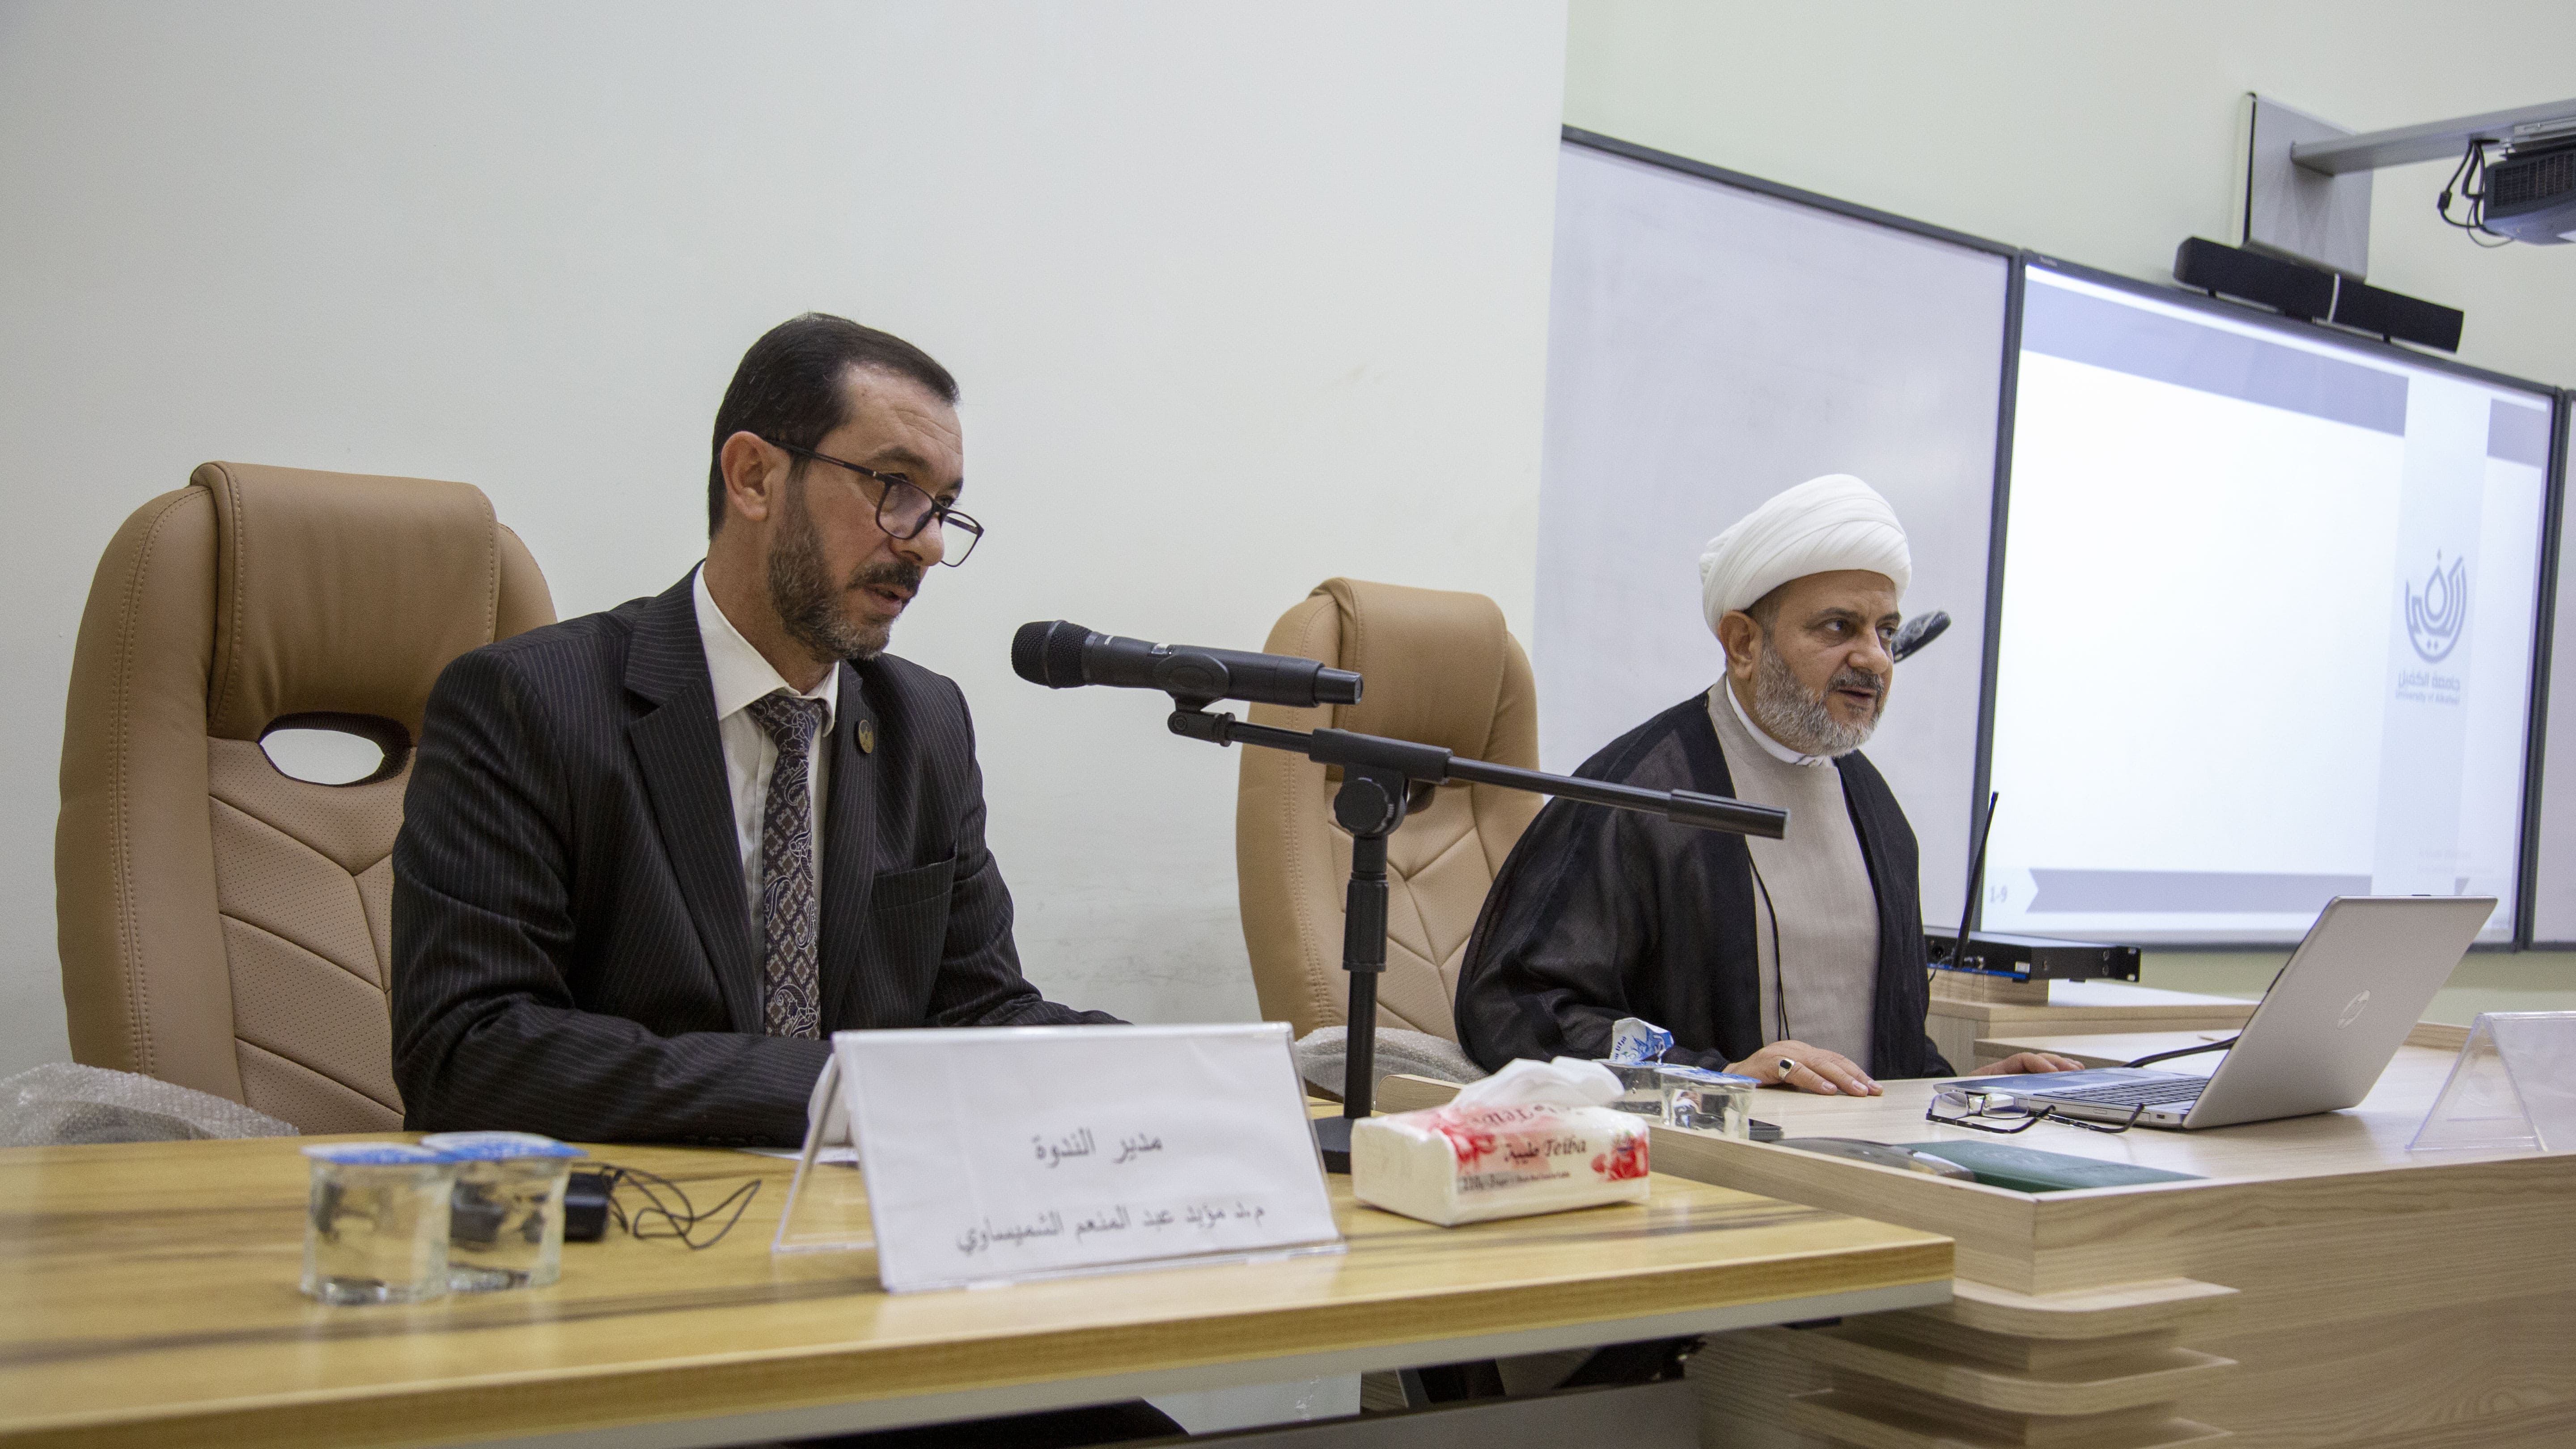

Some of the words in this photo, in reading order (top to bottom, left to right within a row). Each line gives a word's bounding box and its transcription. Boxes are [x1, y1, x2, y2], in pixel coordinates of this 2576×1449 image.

[2398, 670, 2429, 689] الكفيل
[2432, 671, 2460, 691] جامعة
[1032, 1127, 1095, 1168] الندوة
[1113, 1132, 1162, 1164] مدير
[1075, 1204, 1131, 1245] المنعم
[1144, 1208, 1174, 1232] عبد
[1186, 1204, 1226, 1229] مؤيد
